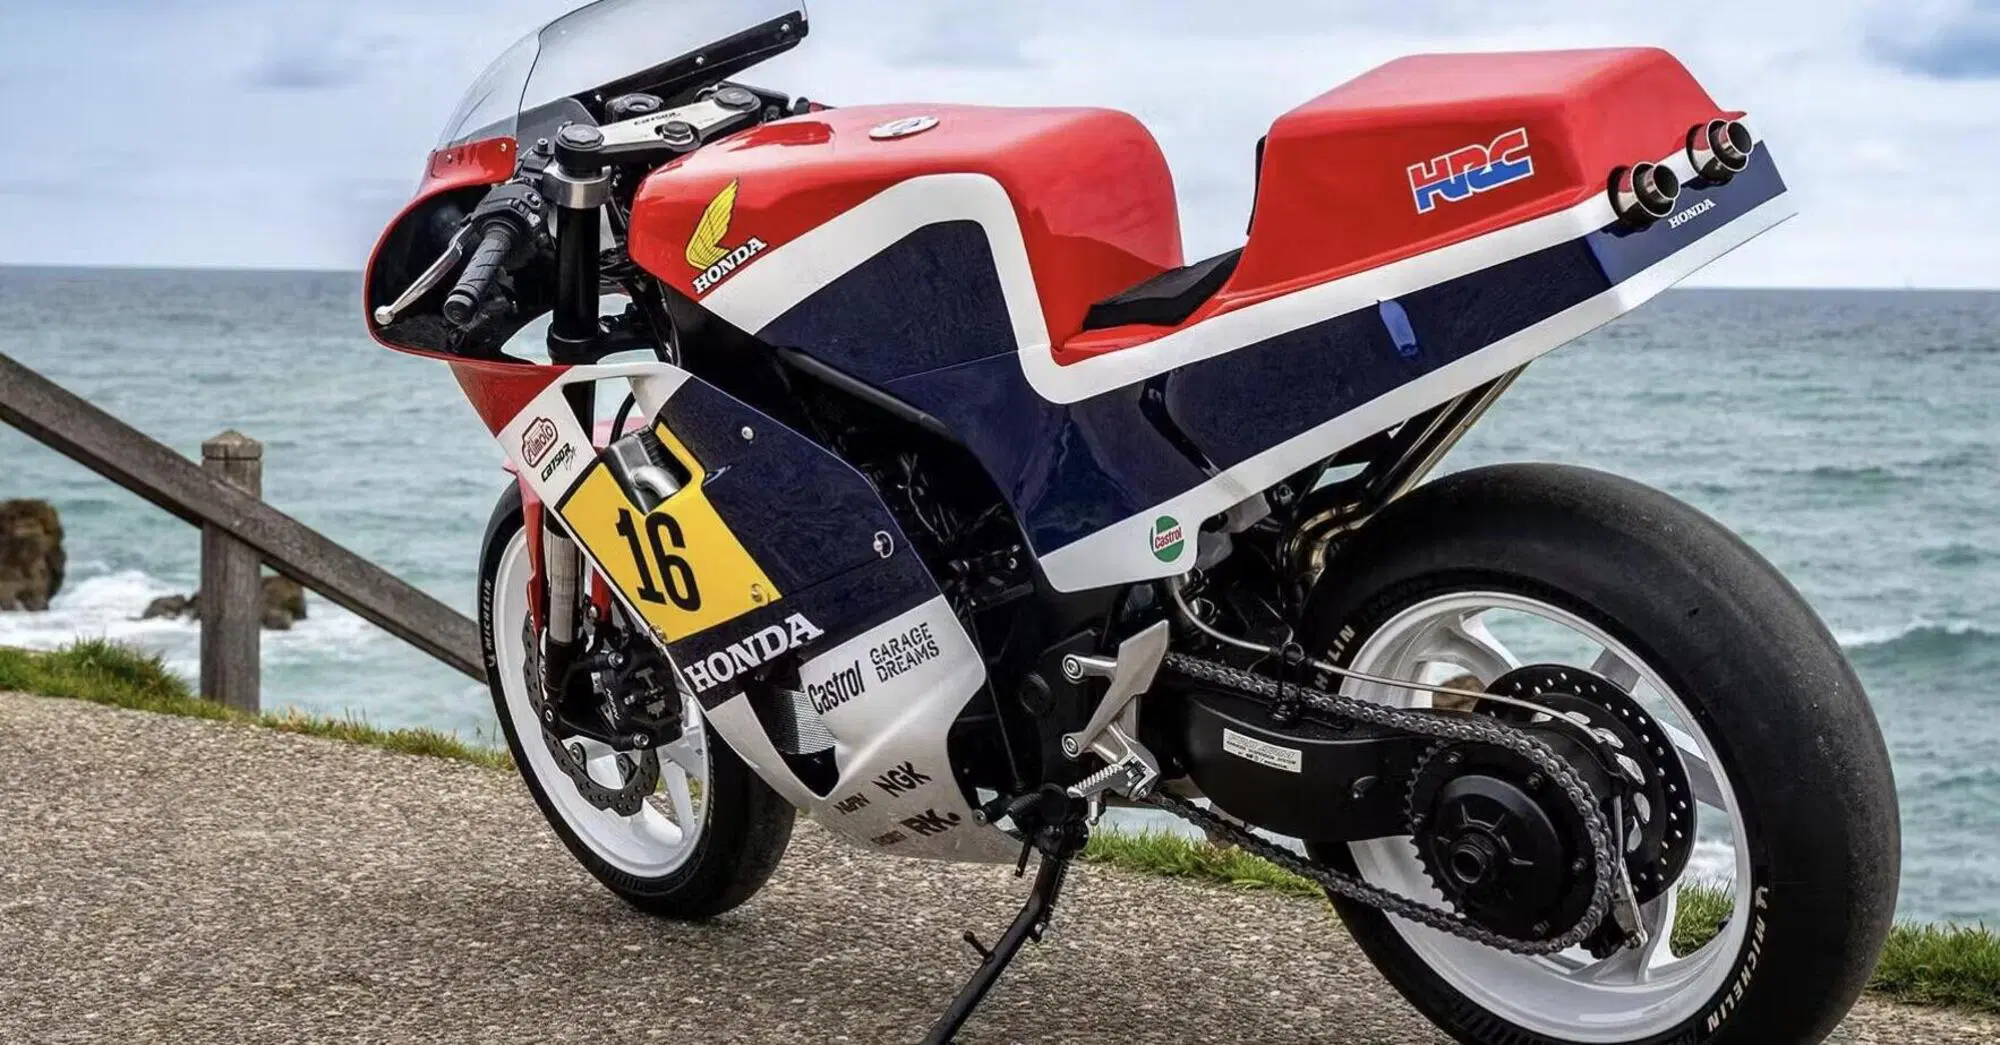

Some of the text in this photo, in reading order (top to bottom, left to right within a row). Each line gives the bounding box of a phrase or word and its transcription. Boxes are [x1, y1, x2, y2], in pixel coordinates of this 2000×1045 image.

[1407, 127, 1534, 214] HRC
[1667, 198, 1717, 229] HONDA
[692, 236, 768, 294] HONDA
[615, 507, 701, 612] 16
[1155, 526, 1182, 549] Castrol
[683, 612, 824, 693] HONDA
[869, 622, 933, 666] GARAGE
[875, 640, 940, 683] DREAMS
[807, 659, 865, 715] Castrol
[871, 761, 933, 798] NGK
[1707, 914, 1767, 1033] MICHELIN
